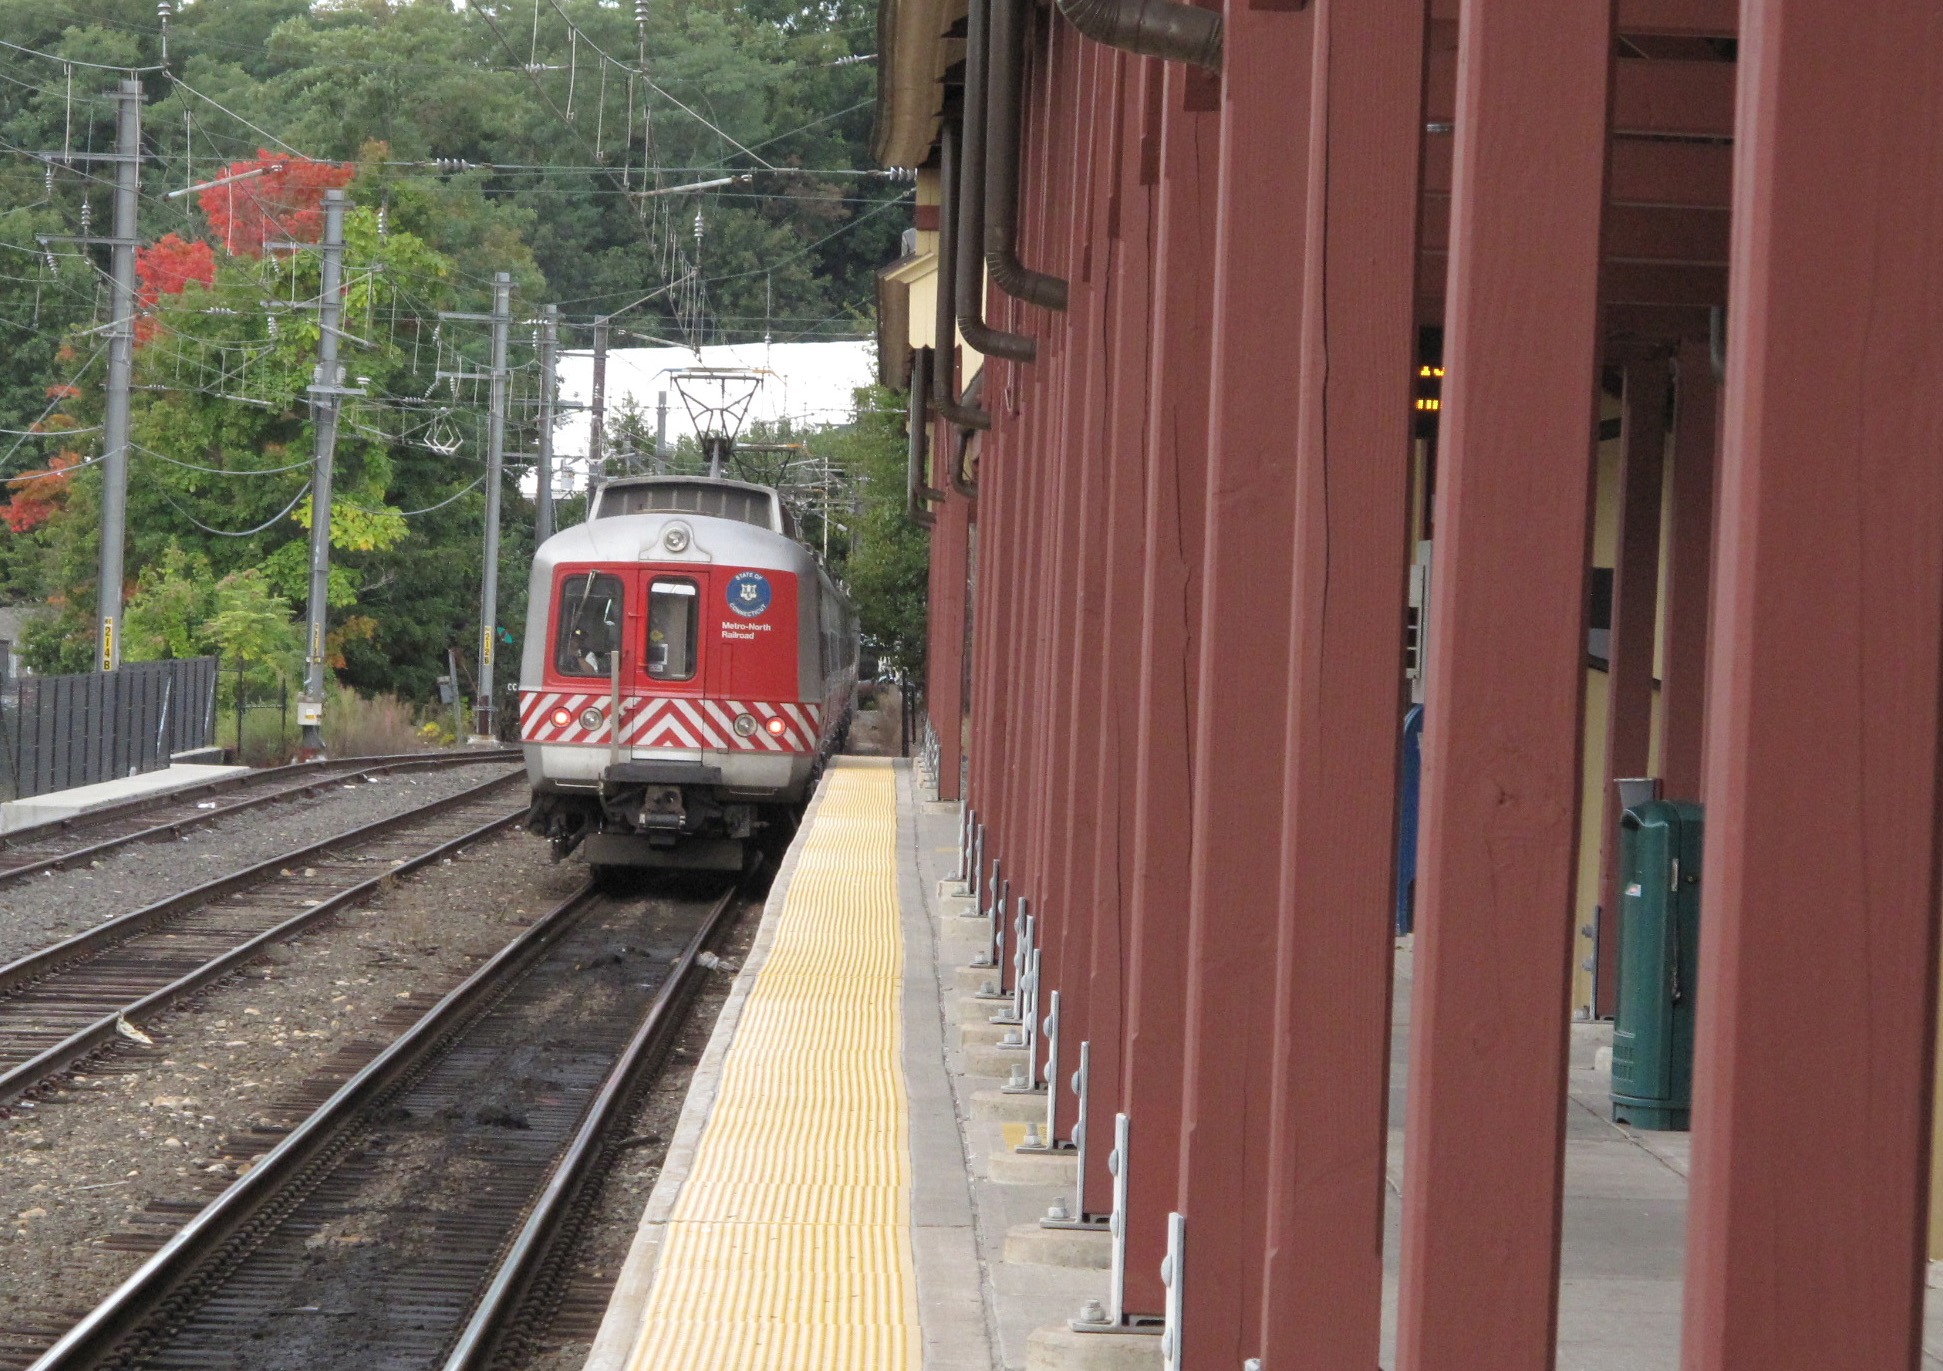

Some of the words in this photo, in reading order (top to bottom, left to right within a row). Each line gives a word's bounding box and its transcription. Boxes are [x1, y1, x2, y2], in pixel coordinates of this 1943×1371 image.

[735, 572, 753, 581] STATE
[729, 602, 767, 617] CONNECTICUT
[721, 621, 771, 631] Metro-North
[721, 631, 755, 640] Railroad
